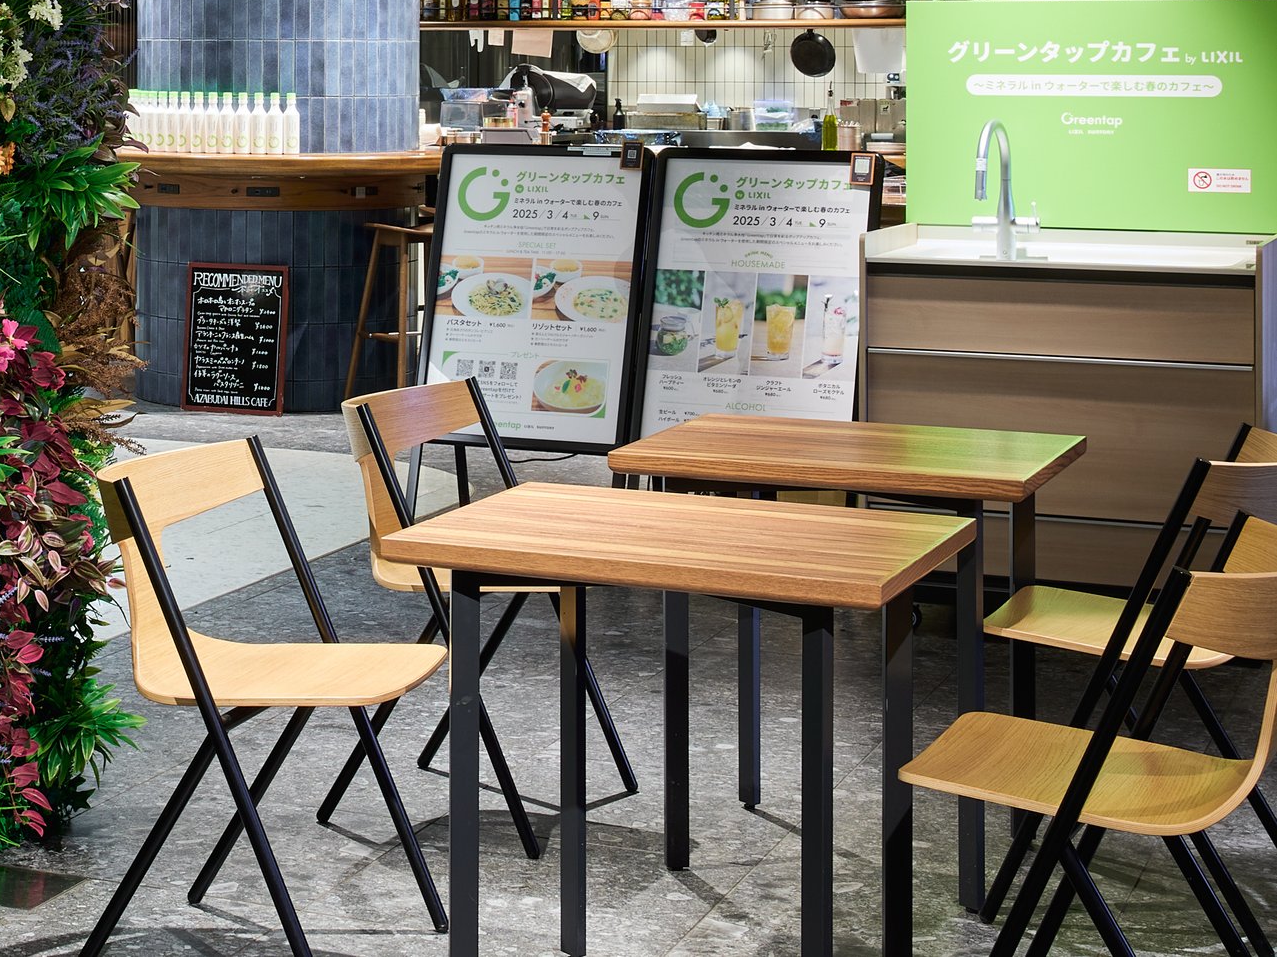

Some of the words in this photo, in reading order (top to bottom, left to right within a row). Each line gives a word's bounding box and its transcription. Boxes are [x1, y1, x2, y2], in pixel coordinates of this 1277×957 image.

[948, 40, 1180, 63] グリーンタップカフェ
[1185, 53, 1197, 65] by
[1201, 51, 1243, 63] LIXIL
[1031, 82, 1041, 90] in
[1061, 112, 1123, 128] Greentap
[516, 171, 625, 185] グリーンタップカフェ
[736, 177, 852, 191] グリーンタップカフェ
[748, 191, 771, 200] LIXIL
[592, 211, 600, 220] 9
[819, 218, 826, 228] 9
[731, 259, 786, 269] HOUSEMADE
[193, 272, 258, 288] RECOMMENDED
[258, 275, 283, 288] MENU
[446, 318, 482, 327] パスタセット
[532, 323, 572, 331] リゾットセット
[193, 393, 229, 405] AZABUDAI
[230, 395, 250, 407] HILLS
[250, 397, 269, 408] CAFE
[725, 402, 766, 412] ALCOHOL
